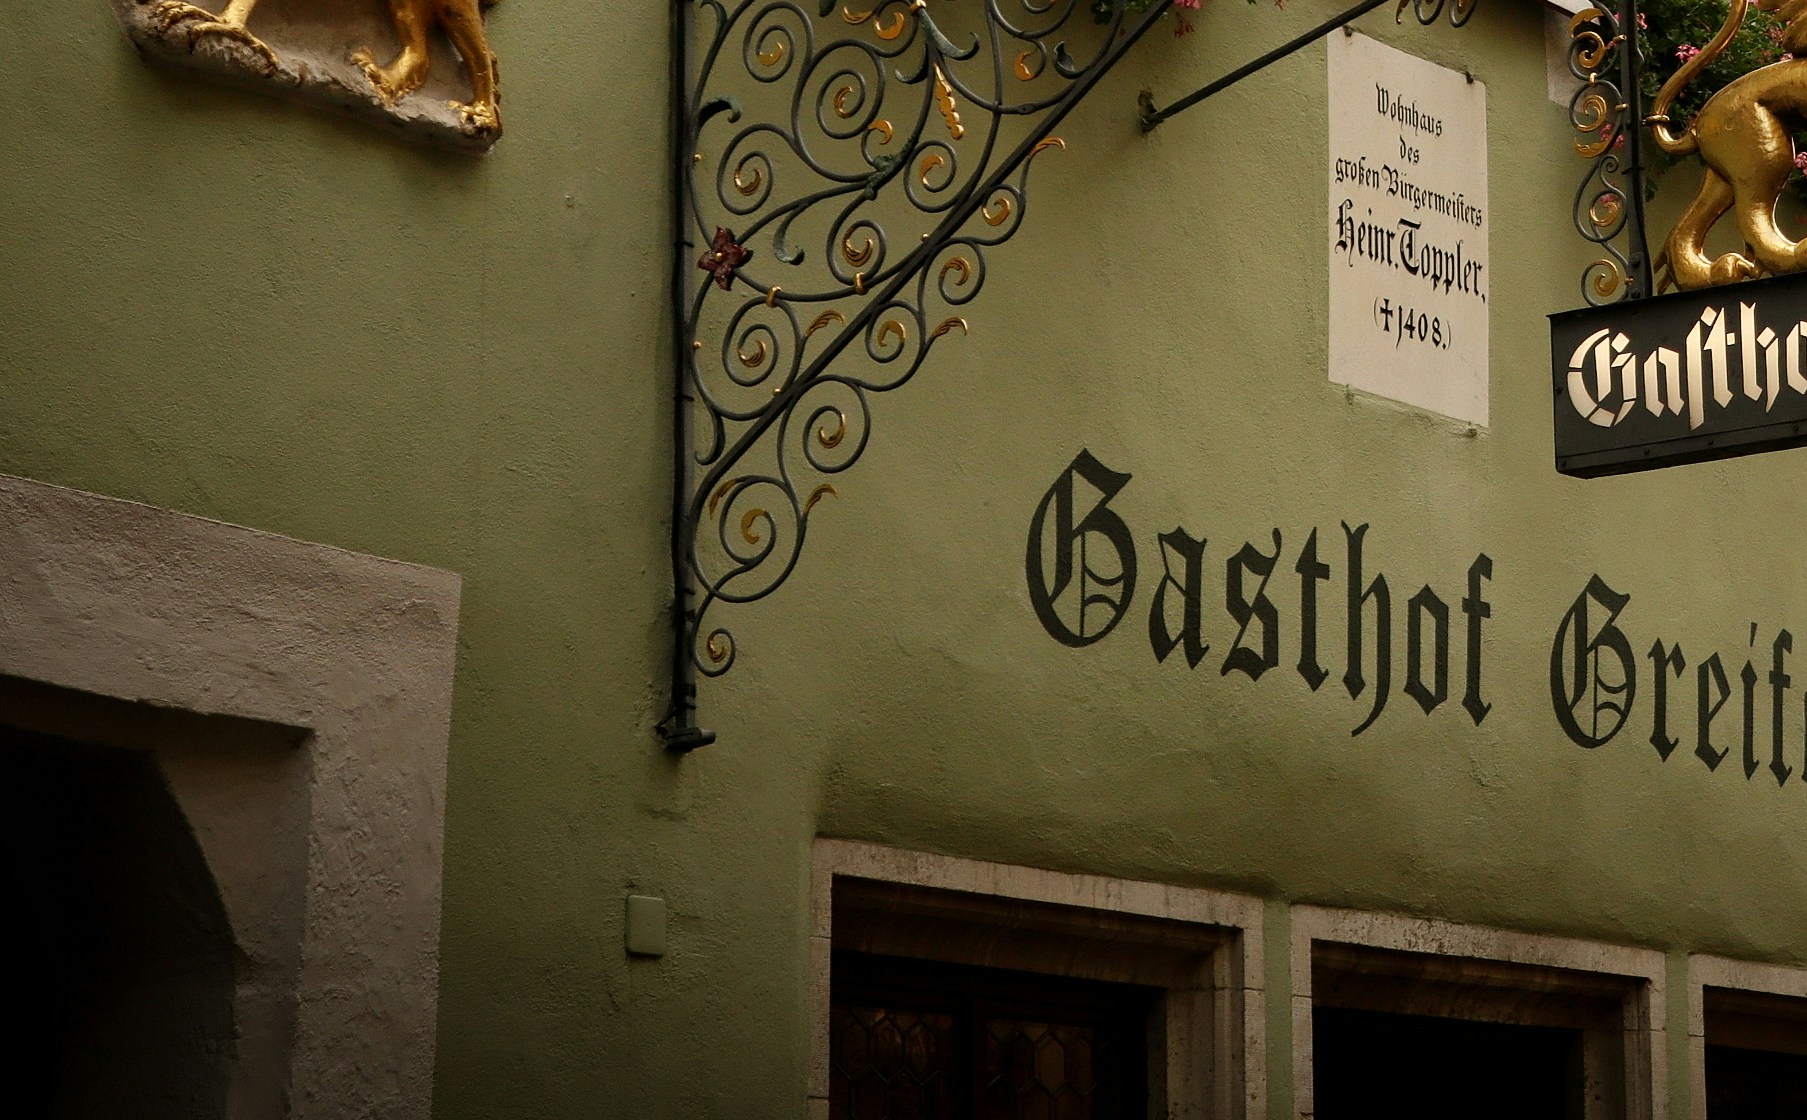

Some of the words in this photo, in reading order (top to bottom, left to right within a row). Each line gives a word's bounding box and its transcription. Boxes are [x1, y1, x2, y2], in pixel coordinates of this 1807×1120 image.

[1376, 82, 1443, 137] Wohnhaus
[1335, 156, 1380, 190] großen
[1399, 135, 1420, 165] des
[1335, 198, 1399, 268] Heinr.
[1025, 448, 1493, 737] Gasthof
